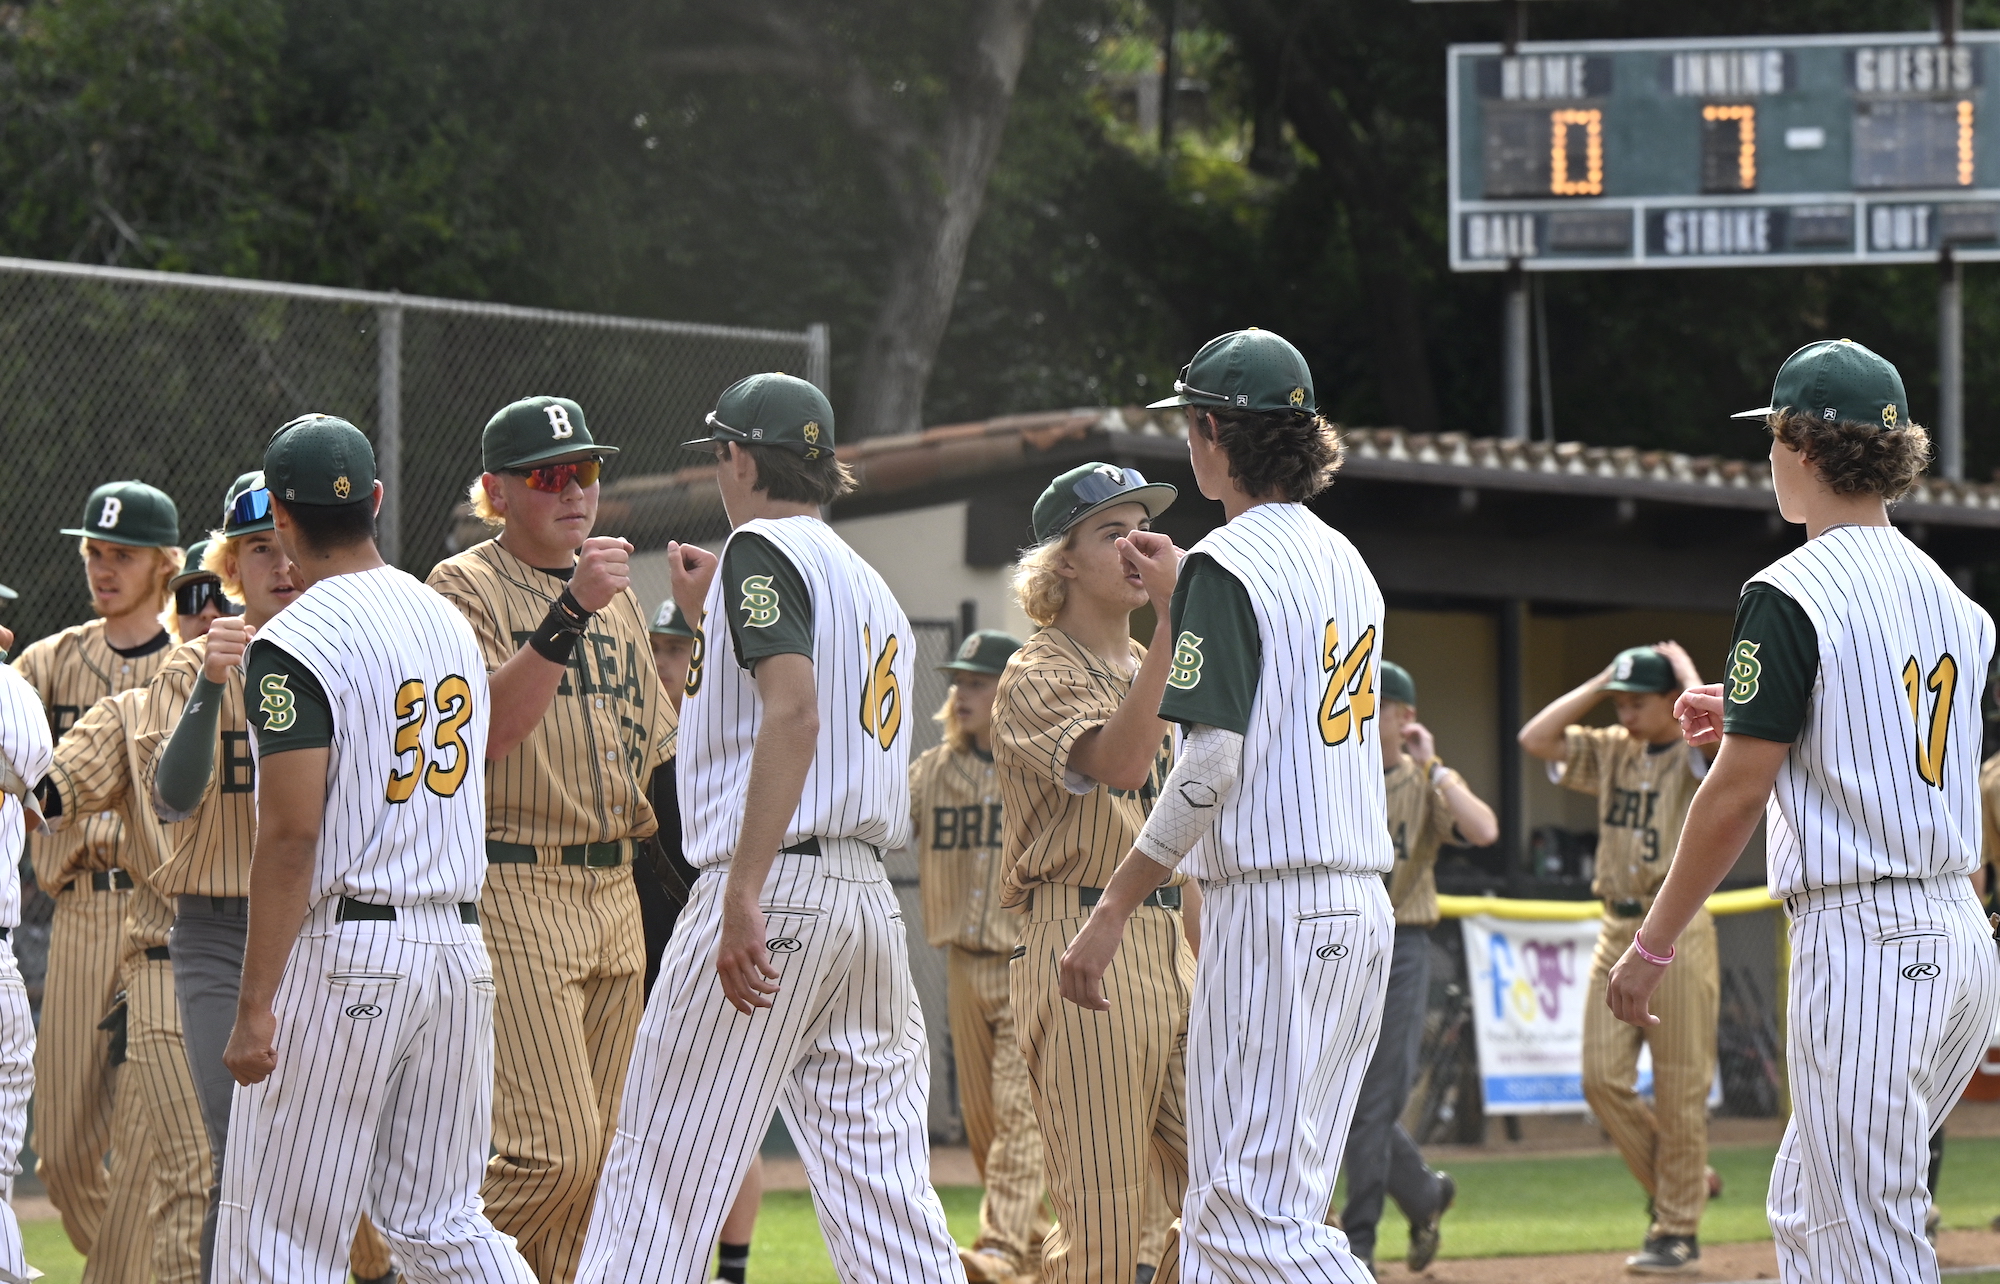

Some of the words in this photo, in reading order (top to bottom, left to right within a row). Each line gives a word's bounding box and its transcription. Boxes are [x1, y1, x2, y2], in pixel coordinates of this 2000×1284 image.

[1673, 51, 1784, 96] INNING
[1856, 46, 1973, 92] GUESTS
[1551, 108, 1602, 195] 0
[1703, 104, 1756, 189] 7
[1957, 100, 1973, 186] 1
[1468, 213, 1537, 258] BALL
[1663, 209, 1771, 254] STRIKE
[1872, 205, 1929, 249] OUT
[543, 404, 574, 440] B
[97, 496, 122, 528] B
[512, 630, 644, 709] REA
[859, 624, 902, 752] 16
[1318, 618, 1375, 746] 24
[386, 674, 472, 804] 33
[1903, 653, 1957, 790] 11
[1642, 829, 1660, 863] 9
